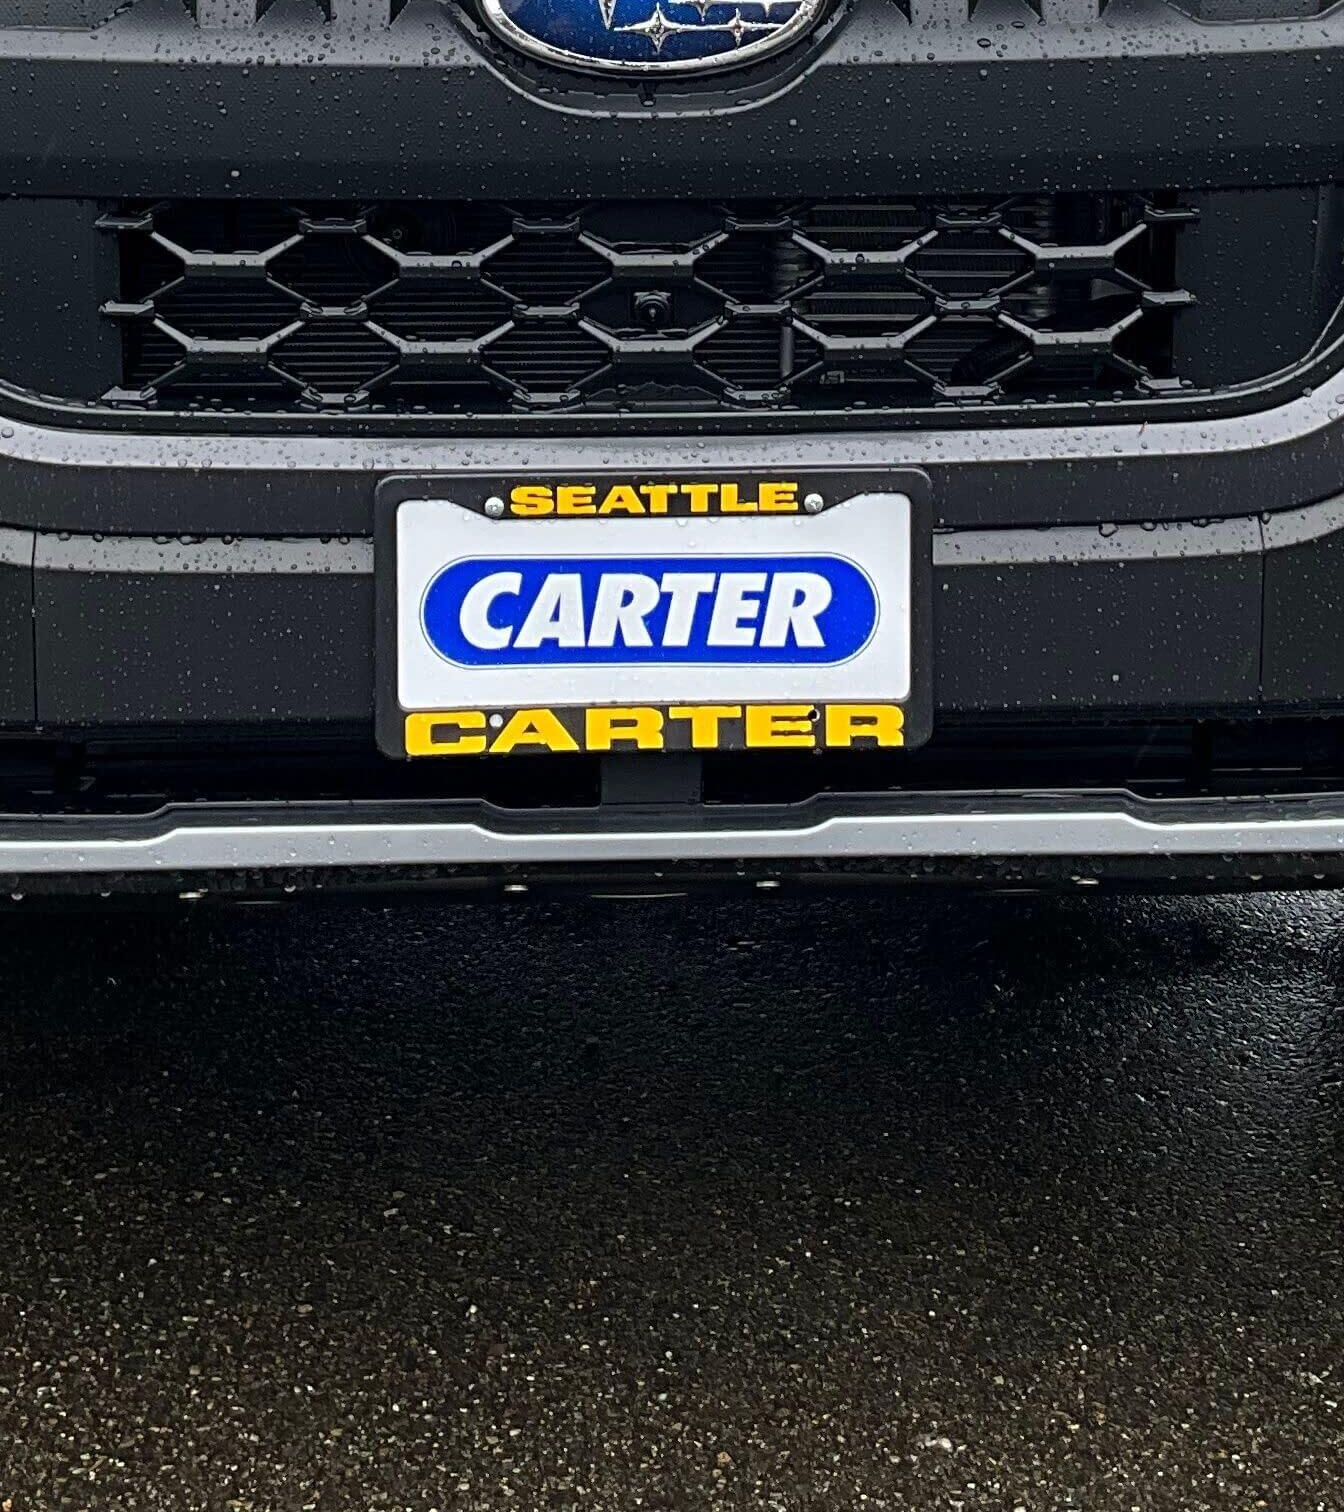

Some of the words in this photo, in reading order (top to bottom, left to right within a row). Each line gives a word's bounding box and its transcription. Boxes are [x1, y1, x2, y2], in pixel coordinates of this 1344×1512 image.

[509, 483, 799, 516] SEATTLE
[459, 571, 832, 649] CARTER
[405, 705, 905, 756] CARTER
